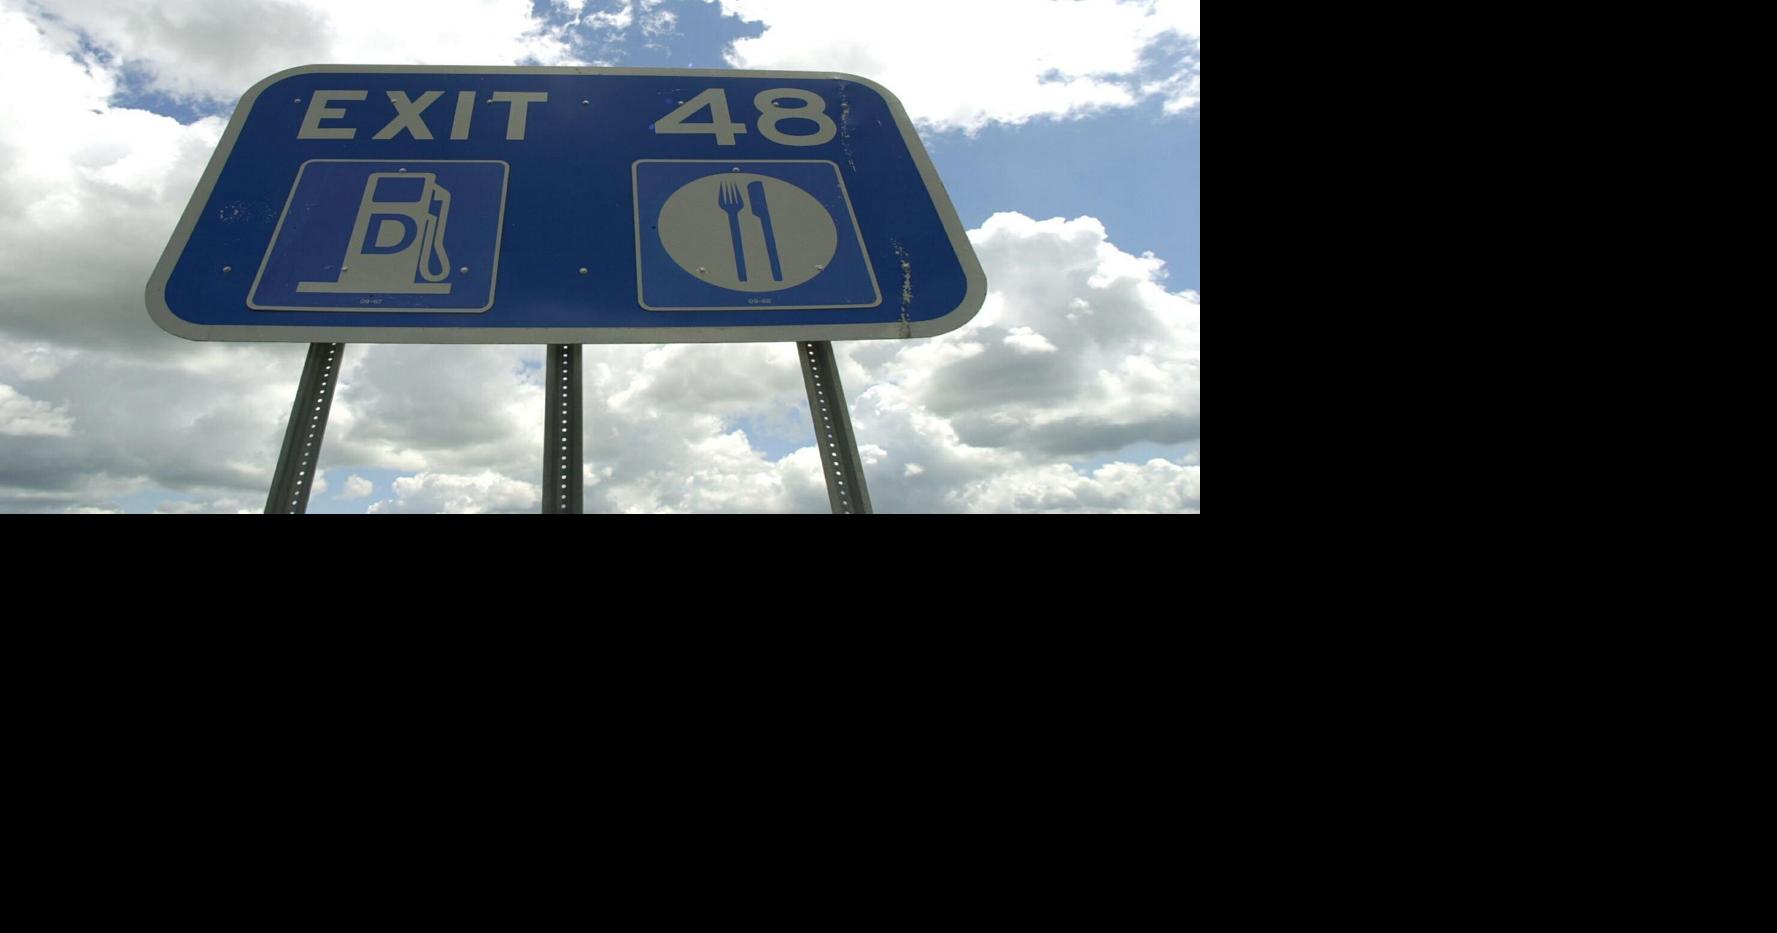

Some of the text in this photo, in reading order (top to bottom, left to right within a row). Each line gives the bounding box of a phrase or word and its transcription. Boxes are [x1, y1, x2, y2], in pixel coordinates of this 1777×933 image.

[296, 87, 838, 147] EXIT 48
[360, 213, 418, 254] D
